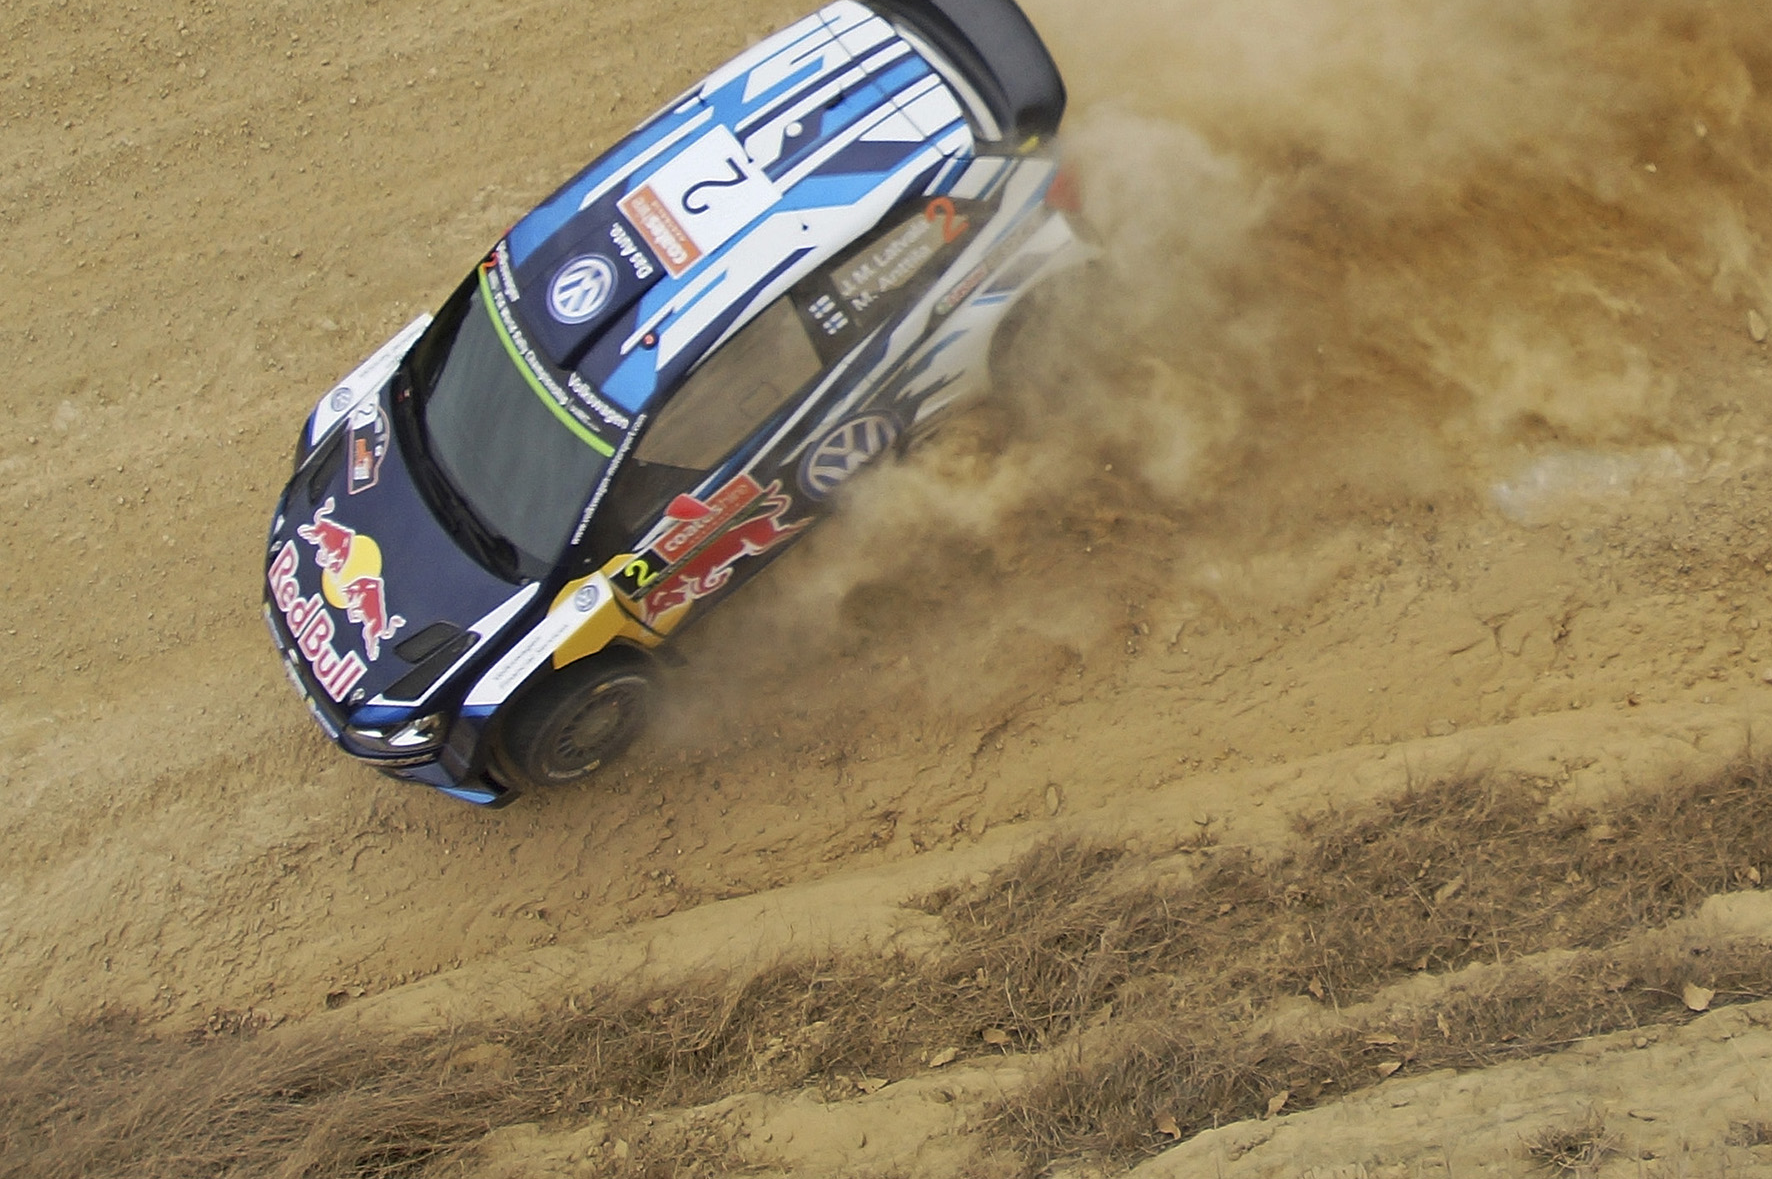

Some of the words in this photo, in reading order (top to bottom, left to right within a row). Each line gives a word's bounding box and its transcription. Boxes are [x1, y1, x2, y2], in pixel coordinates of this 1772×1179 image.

[682, 157, 749, 215] 2
[924, 196, 970, 245] 2
[629, 252, 654, 280] Das
[568, 371, 630, 430] Volkswagen
[624, 559, 661, 588] 2
[268, 540, 324, 639] Red
[298, 608, 368, 703] Bull
